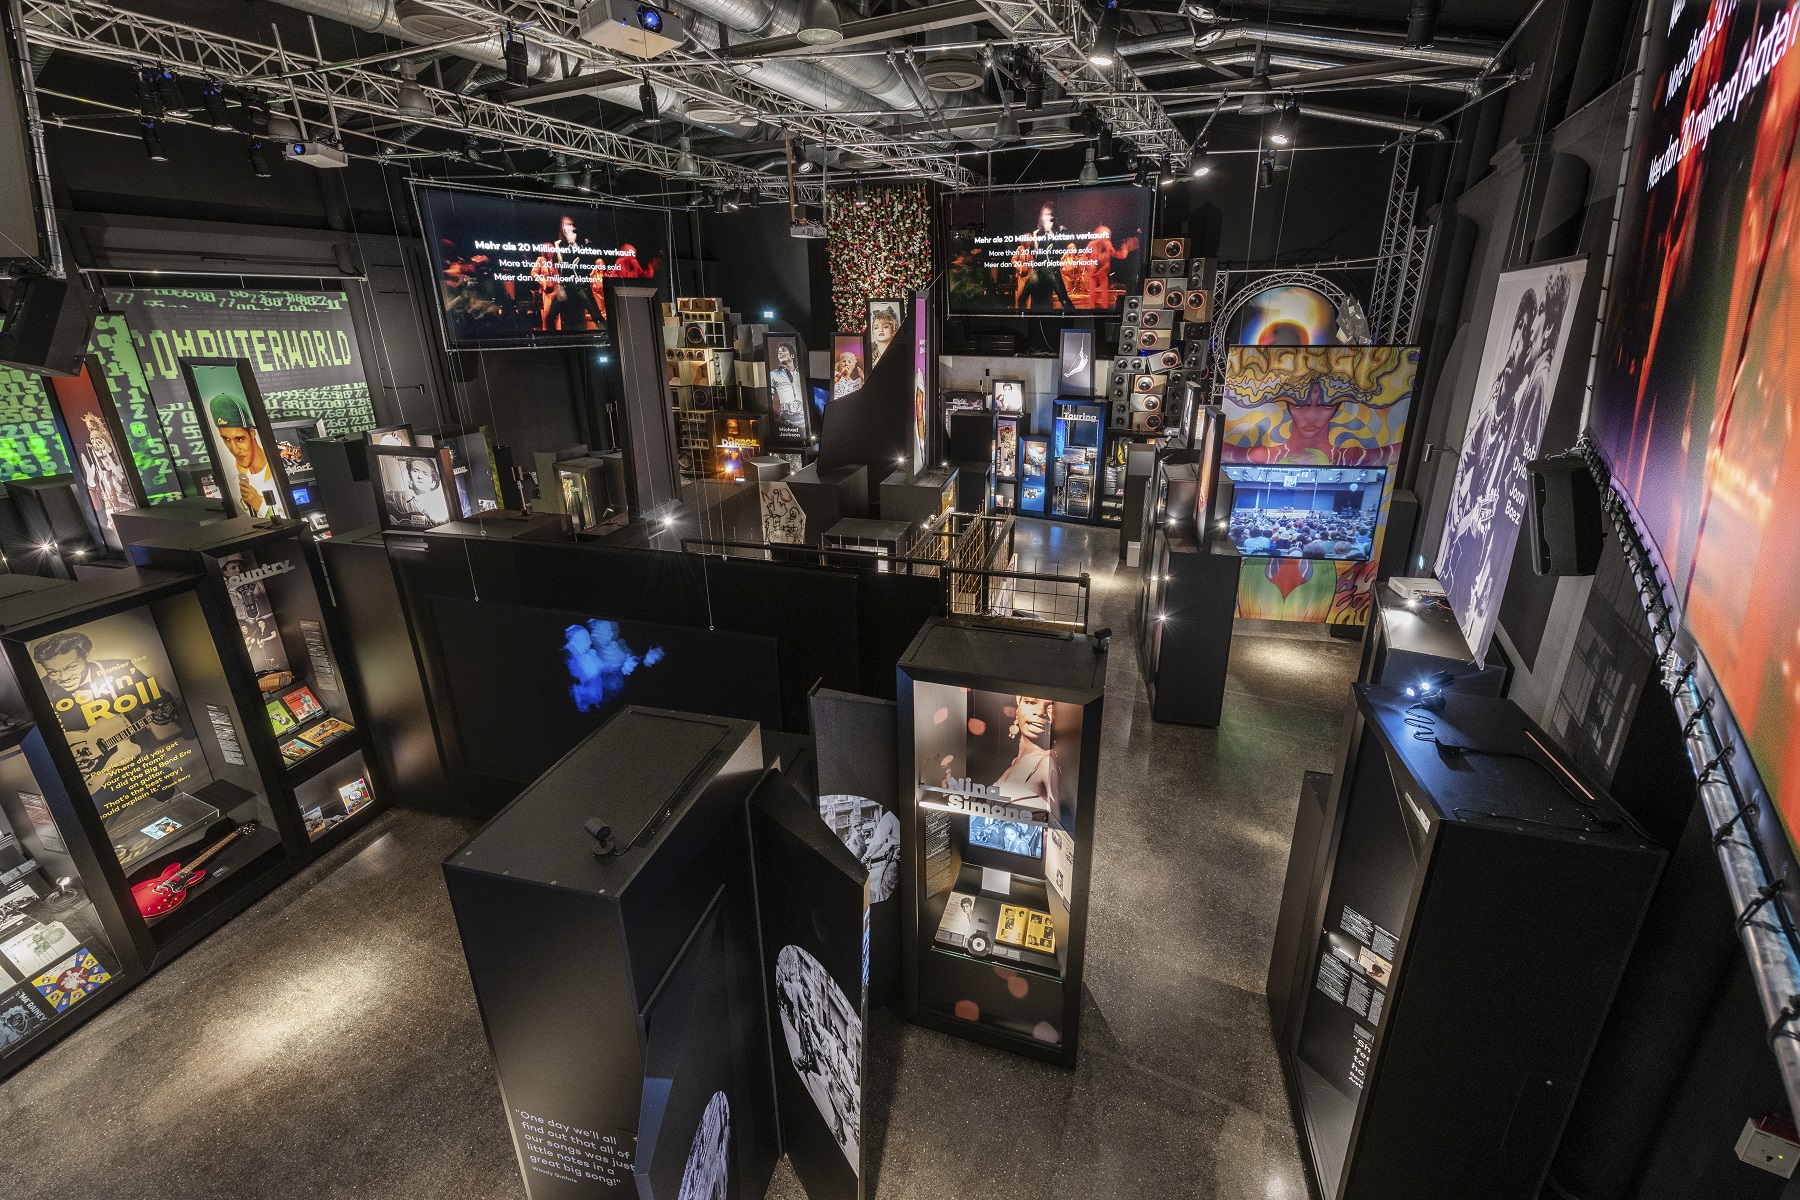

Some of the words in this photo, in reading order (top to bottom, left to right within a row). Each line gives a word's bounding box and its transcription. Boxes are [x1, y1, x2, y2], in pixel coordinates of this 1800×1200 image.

[474, 240, 500, 250] Mehr
[502, 242, 517, 251] als
[517, 243, 531, 252] 20
[532, 243, 571, 254] Millionen
[572, 245, 602, 256] Platten
[603, 248, 636, 257] verkauft
[974, 236, 992, 244] Mehr
[992, 235, 1003, 243] als
[1004, 235, 1014, 243] 20
[1015, 233, 1047, 243] Millionen
[1047, 233, 1075, 242] Platten
[1076, 231, 1109, 240] verkauft
[988, 249, 1004, 257] More
[1005, 249, 1020, 257] than
[1030, 247, 1052, 256] million
[1078, 246, 1093, 254] sold
[498, 259, 521, 268] More
[522, 259, 540, 268] than
[541, 260, 553, 269] 20
[554, 260, 578, 270] million
[579, 262, 607, 271] records
[607, 263, 621, 271] sold
[984, 260, 999, 268] Meer
[1000, 260, 1012, 268] dan
[494, 272, 516, 281] Meer
[517, 273, 533, 282] dan
[534, 273, 545, 282] 20
[1063, 412, 1097, 423] Touring
[1522, 440, 1537, 461] Bob
[1509, 482, 1525, 507] Joan
[1504, 498, 1521, 526] Baez
[96, 661, 130, 677] Pionier
[131, 655, 147, 665] des
[81, 676, 161, 727] Roll
[136, 754, 149, 764] did
[150, 748, 165, 759] you
[165, 741, 179, 751] get
[101, 776, 120, 790] your
[121, 766, 141, 779] style
[115, 779, 129, 789] did
[129, 772, 144, 782] the
[144, 766, 158, 776] Big
[158, 755, 178, 768] Band
[179, 748, 192, 758] Era
[128, 782, 139, 790] on
[131, 787, 145, 796] the
[145, 776, 164, 789] best
[163, 770, 180, 780] way
[948, 776, 1001, 800] Nina
[121, 792, 150, 809] explain
[947, 794, 1033, 822] Simone
[27, 1001, 48, 1022] RAINEY
[1354, 1055, 1365, 1067] to
[521, 1121, 545, 1134] find
[547, 1129, 567, 1141] out
[570, 1135, 597, 1150] that
[599, 1143, 614, 1155] all
[617, 1149, 631, 1160] of
[547, 1118, 570, 1133] day
[602, 1133, 617, 1145] all
[524, 1133, 544, 1145] our
[546, 1138, 582, 1156] songs
[584, 1149, 609, 1164] was
[526, 1142, 554, 1157] little
[556, 1152, 591, 1167] notes
[593, 1160, 605, 1172] in
[607, 1167, 615, 1175] a
[529, 1154, 562, 1170] great
[563, 1162, 582, 1177] big
[531, 1165, 553, 1177] Woody
[554, 1172, 578, 1184] Guthrie
